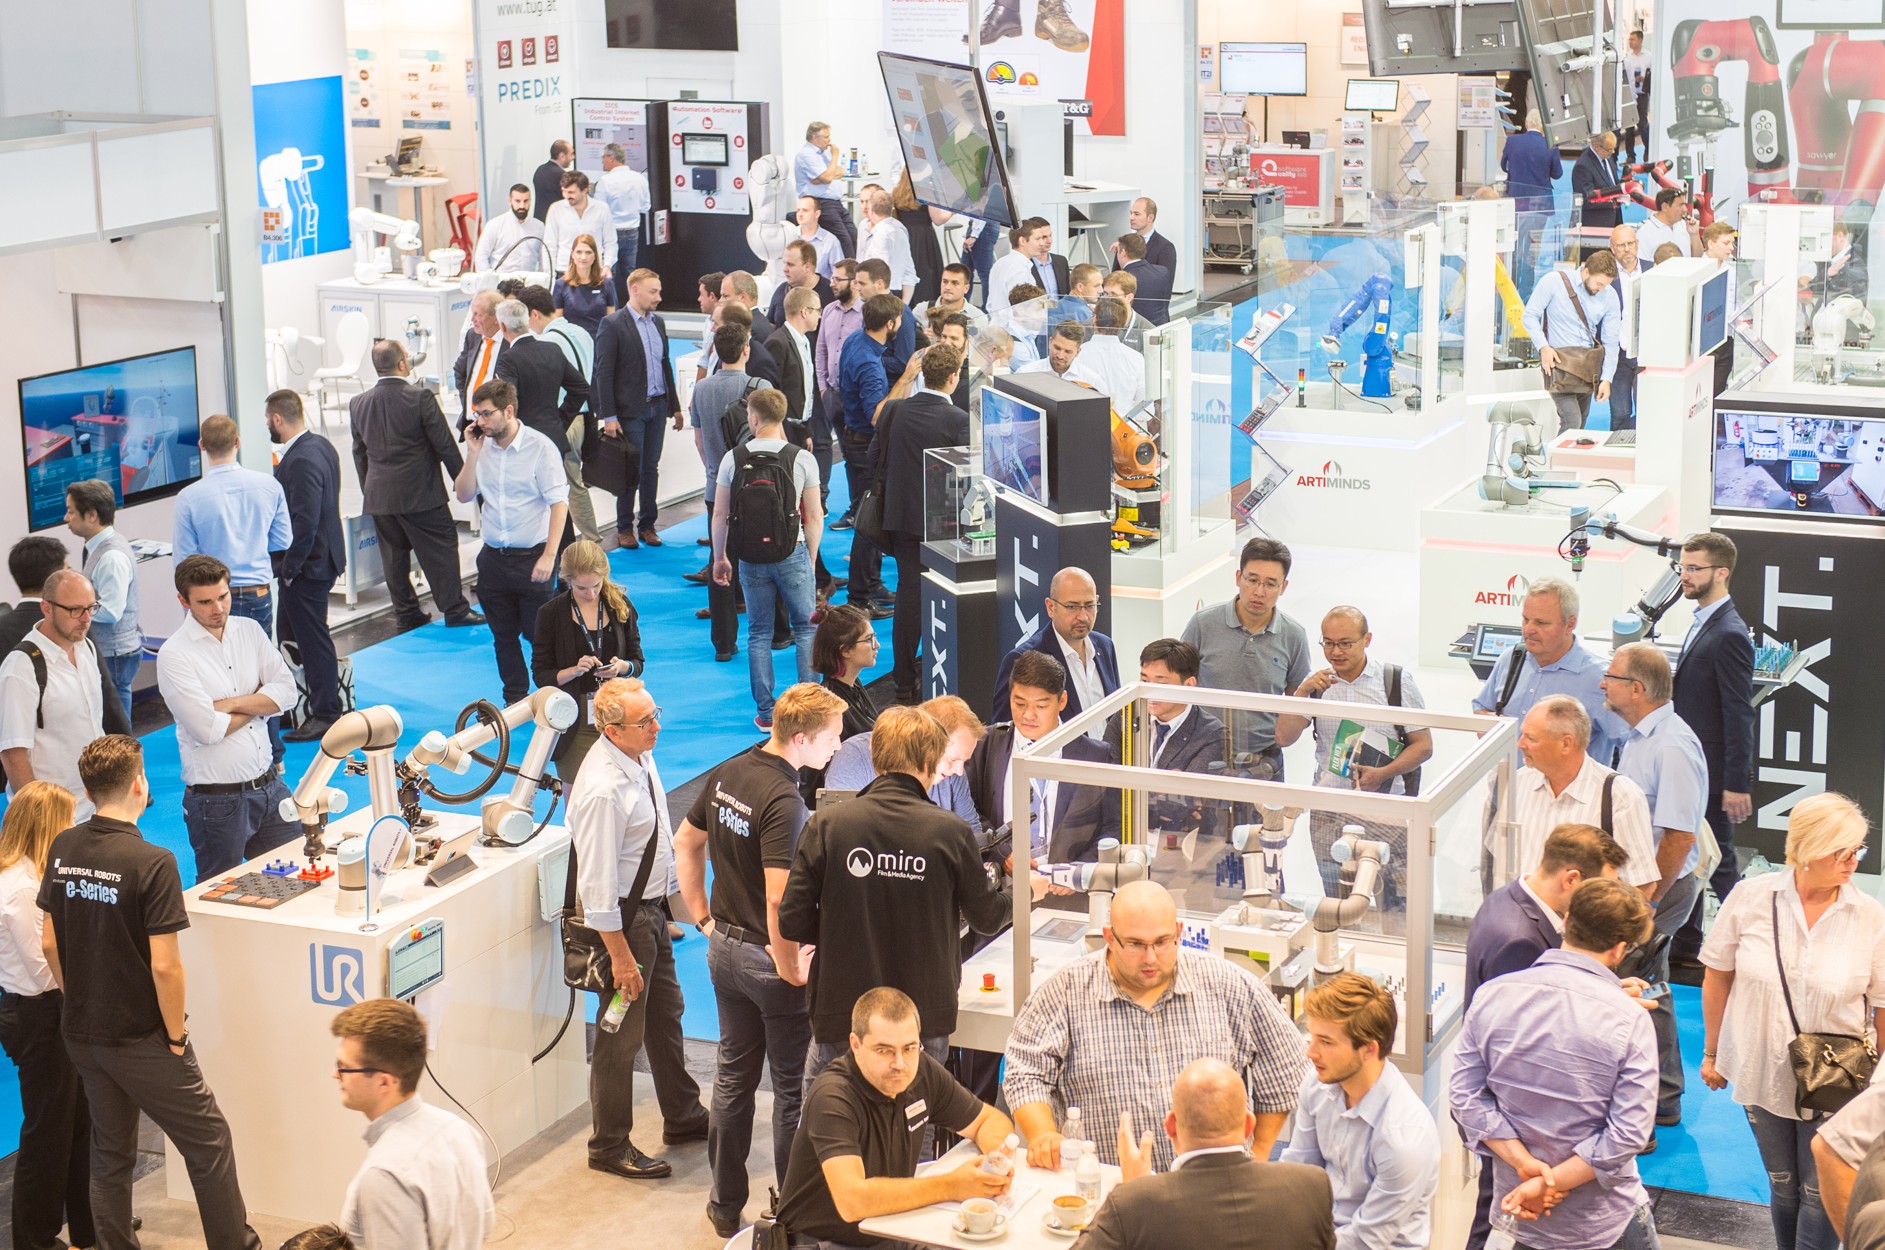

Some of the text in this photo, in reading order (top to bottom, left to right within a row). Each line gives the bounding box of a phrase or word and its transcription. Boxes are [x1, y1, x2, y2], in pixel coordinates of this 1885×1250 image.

[498, 75, 561, 103] PREDIX
[330, 304, 363, 312] AIRSKIN
[1296, 475, 1371, 490] ARTIMINDS
[877, 849, 926, 873] miro
[58, 866, 122, 882] UNIVERSAL ROBOTS
[906, 873, 925, 881] Agency
[66, 879, 119, 905] e-Series
